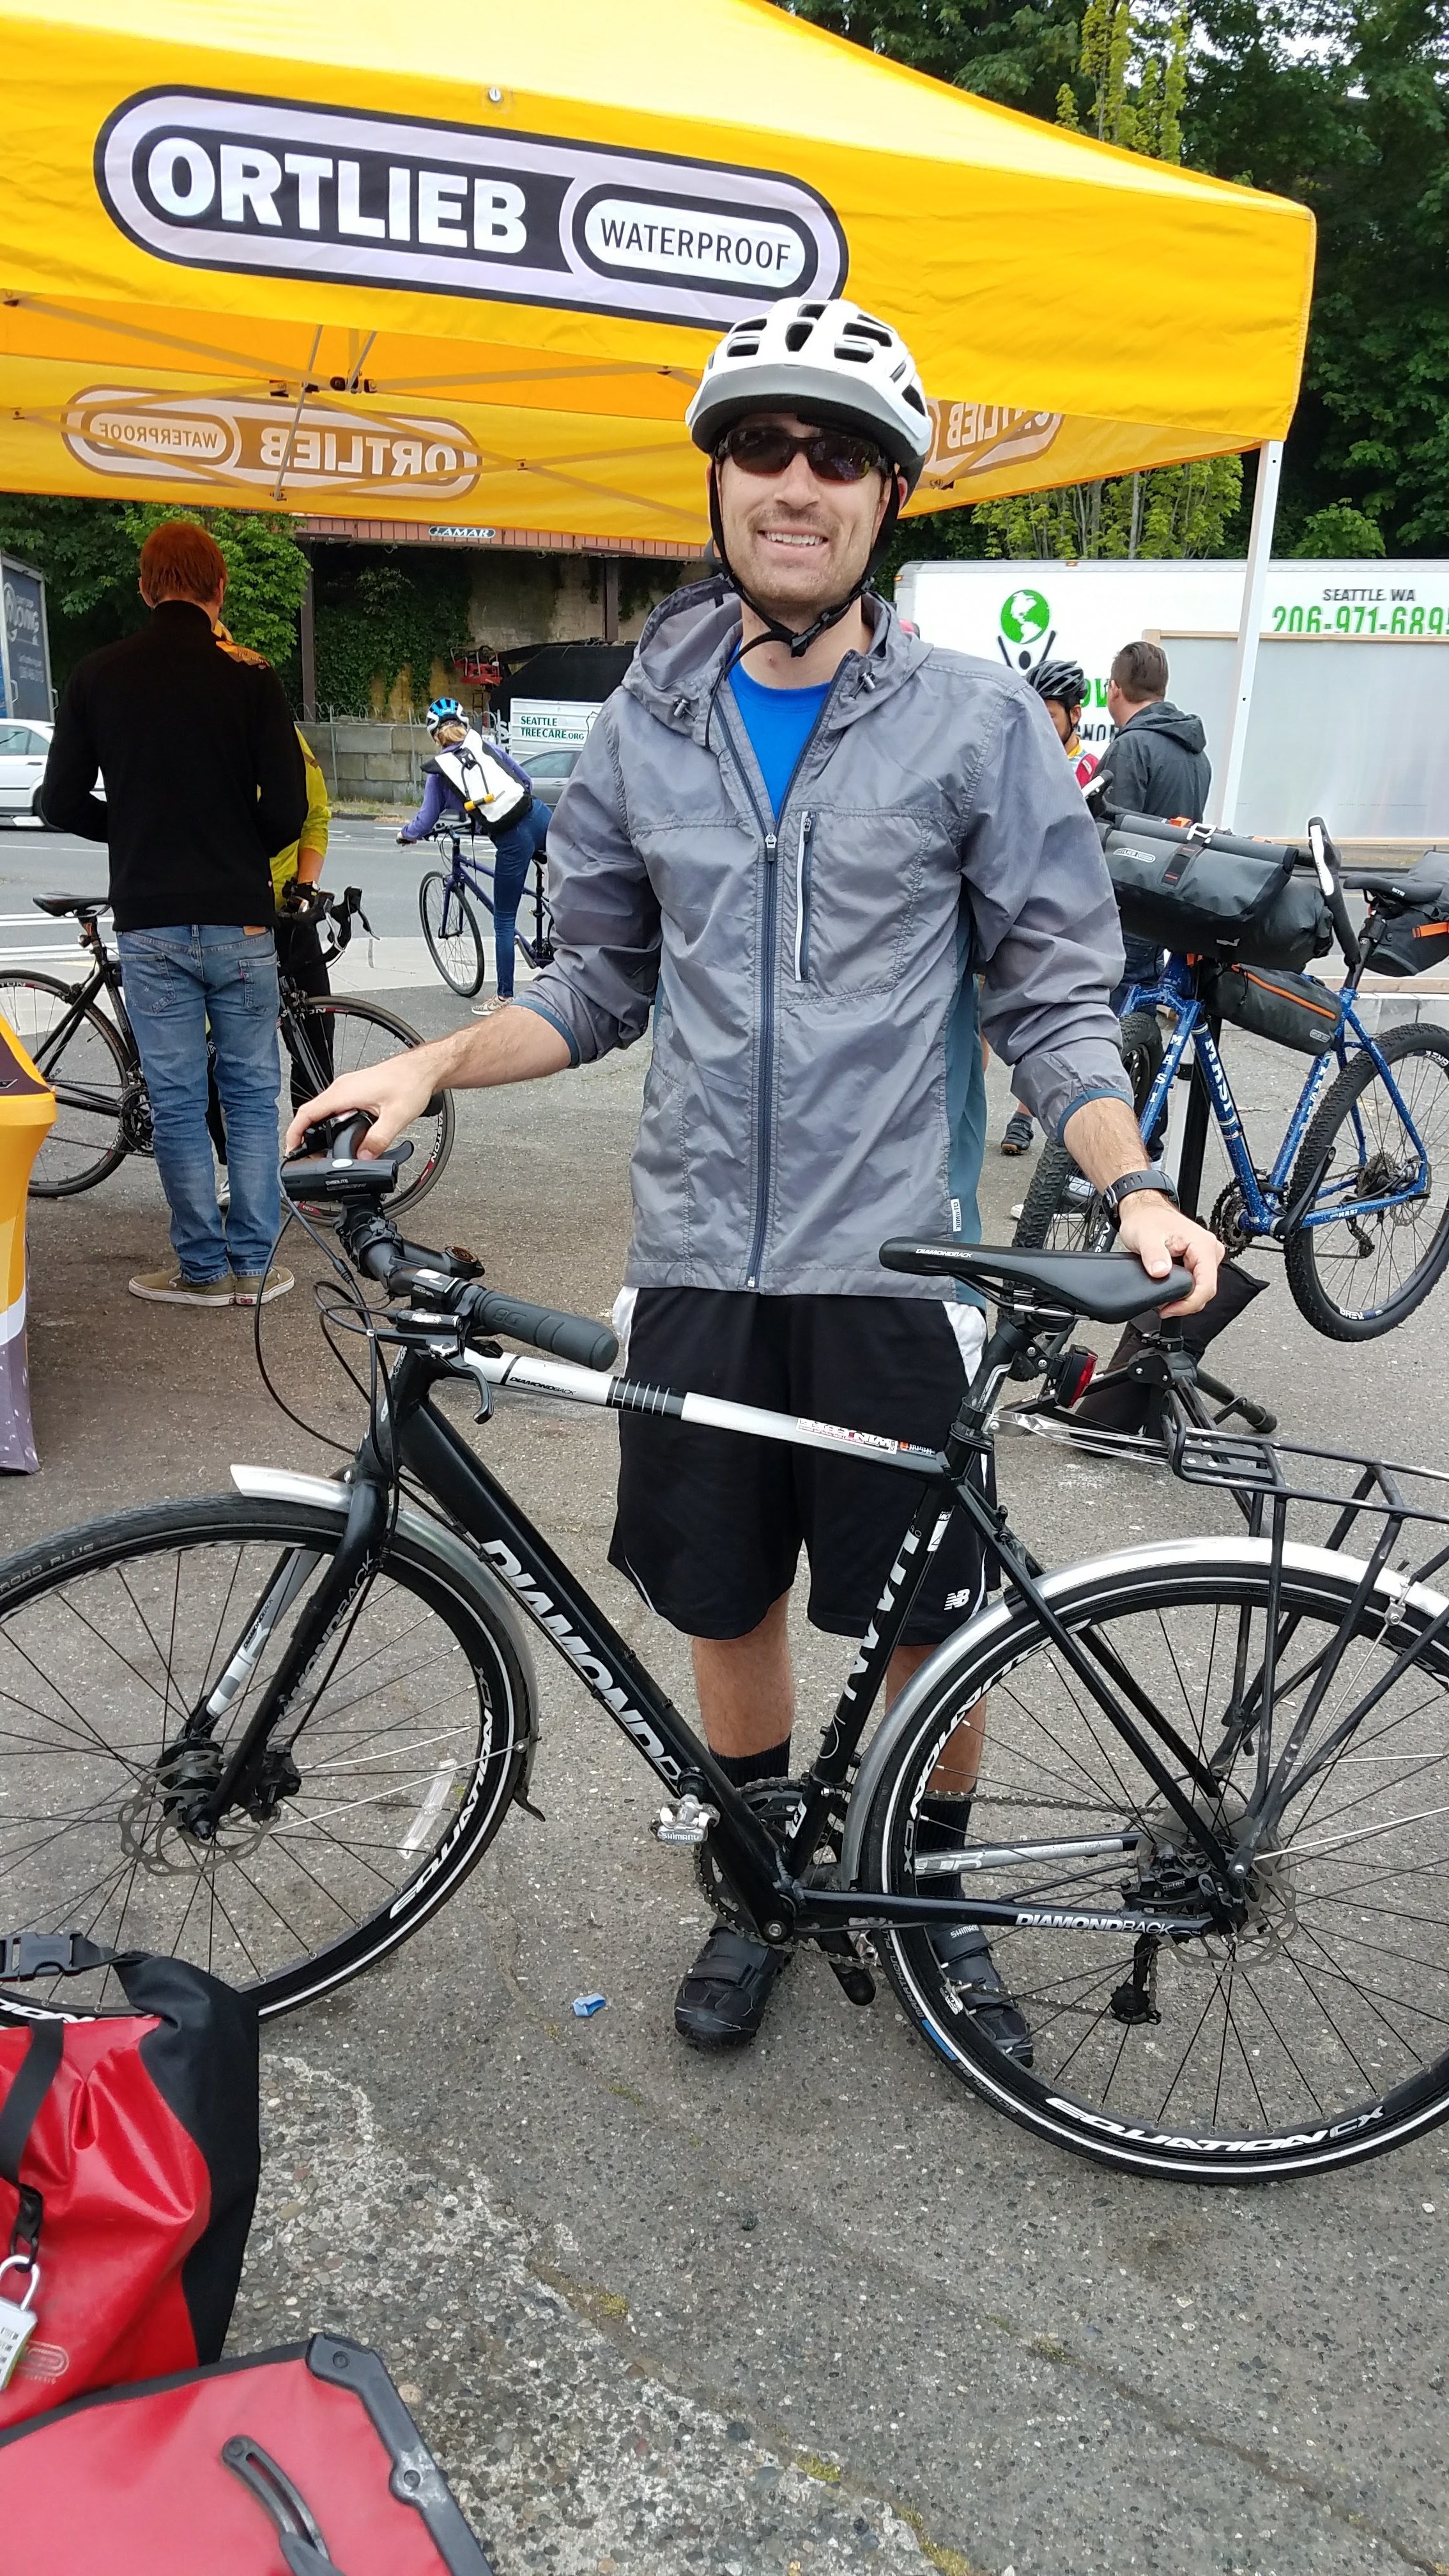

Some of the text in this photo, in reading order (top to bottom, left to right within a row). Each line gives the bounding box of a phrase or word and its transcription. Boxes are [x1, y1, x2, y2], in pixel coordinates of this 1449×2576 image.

[147, 135, 792, 271] ORTLIEB WATERPROOF
[434, 528, 490, 537] LAMAR
[1390, 588, 1416, 601] WA
[1273, 605, 1449, 634] 206-971-689
[520, 716, 558, 727] SEATTLE
[1149, 1034, 1184, 1103] MASI
[509, 1376, 578, 1395] DIAMONDBACK
[1015, 1913, 1175, 1935] DIAMONDBACK
[890, 1955, 924, 2018] MARATHON
[1045, 2096, 1384, 2152] EQUATION CX
